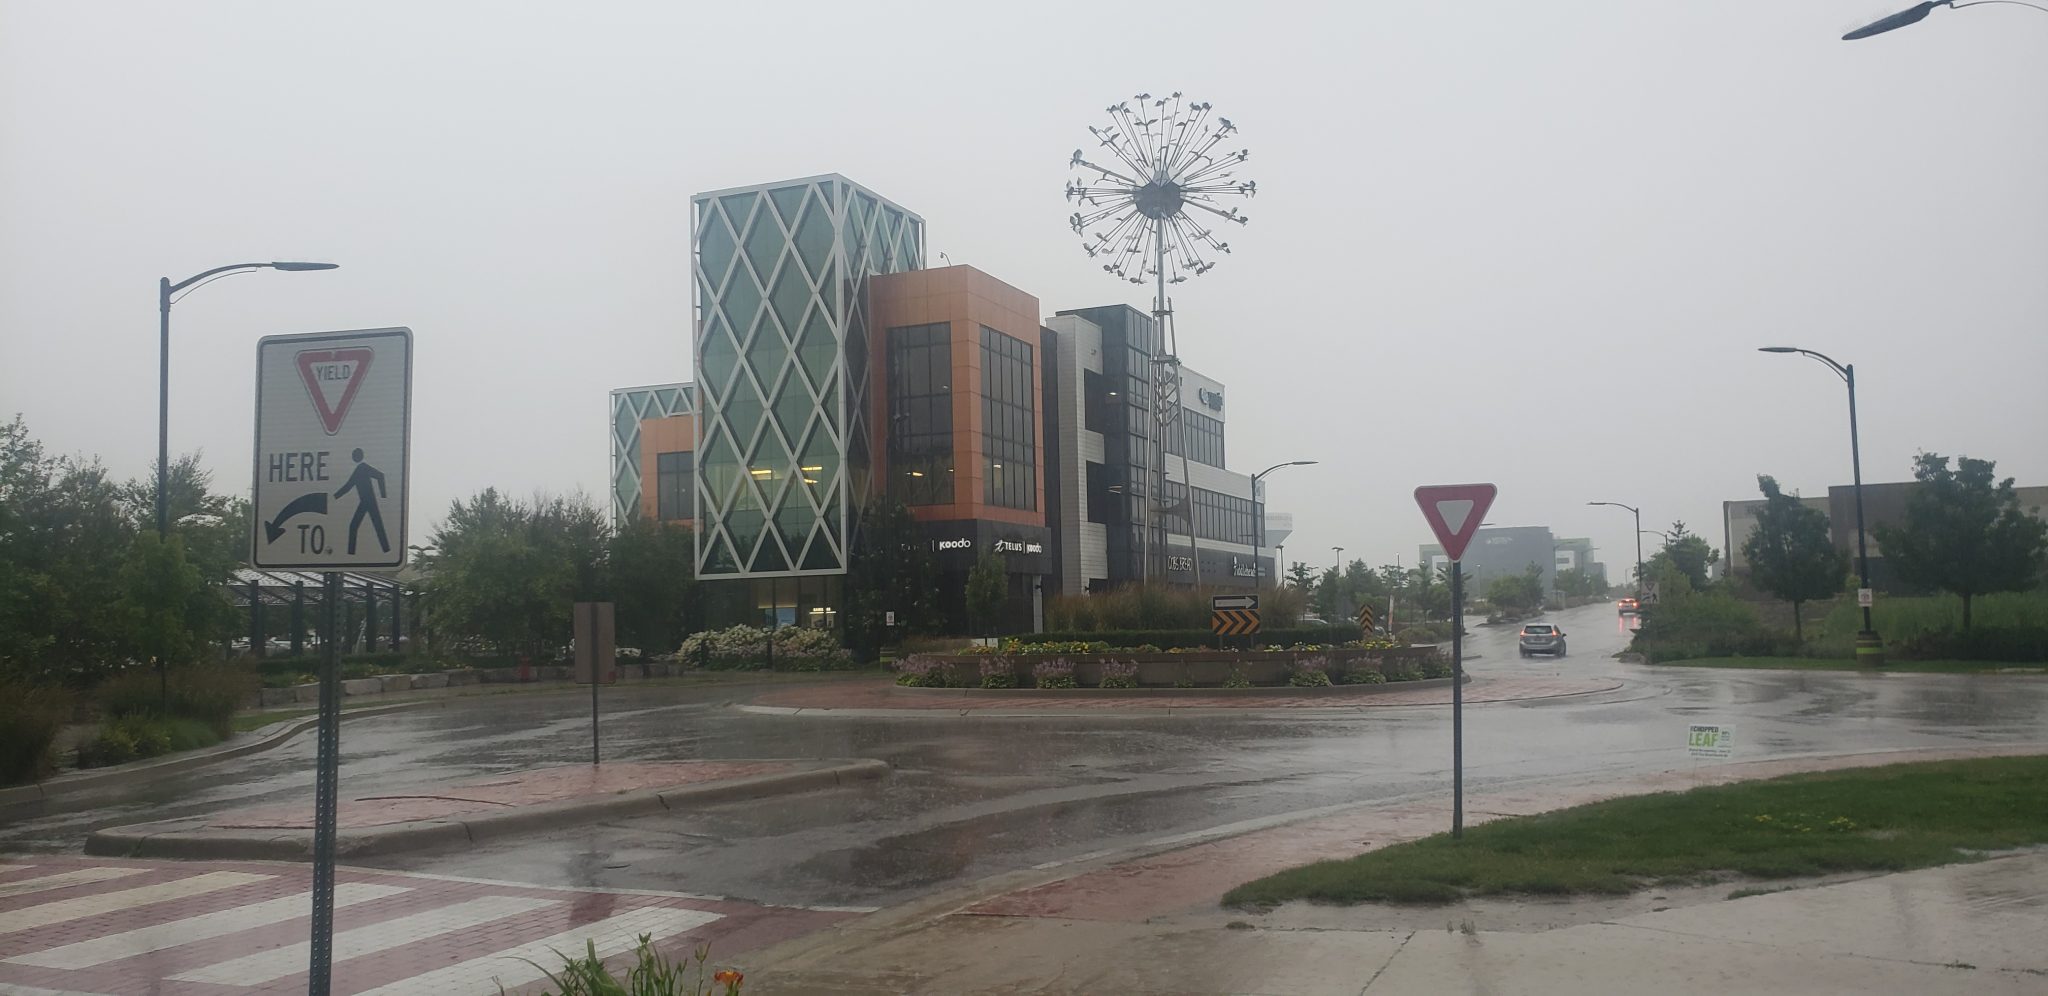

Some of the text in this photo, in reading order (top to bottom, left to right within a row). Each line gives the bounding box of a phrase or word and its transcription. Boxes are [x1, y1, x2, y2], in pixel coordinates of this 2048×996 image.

[316, 365, 350, 380] YIELD
[269, 452, 330, 482] HERE
[297, 525, 325, 554] TO
[1004, 541, 1023, 552] TELUS
[1689, 732, 1719, 747] LEAF
